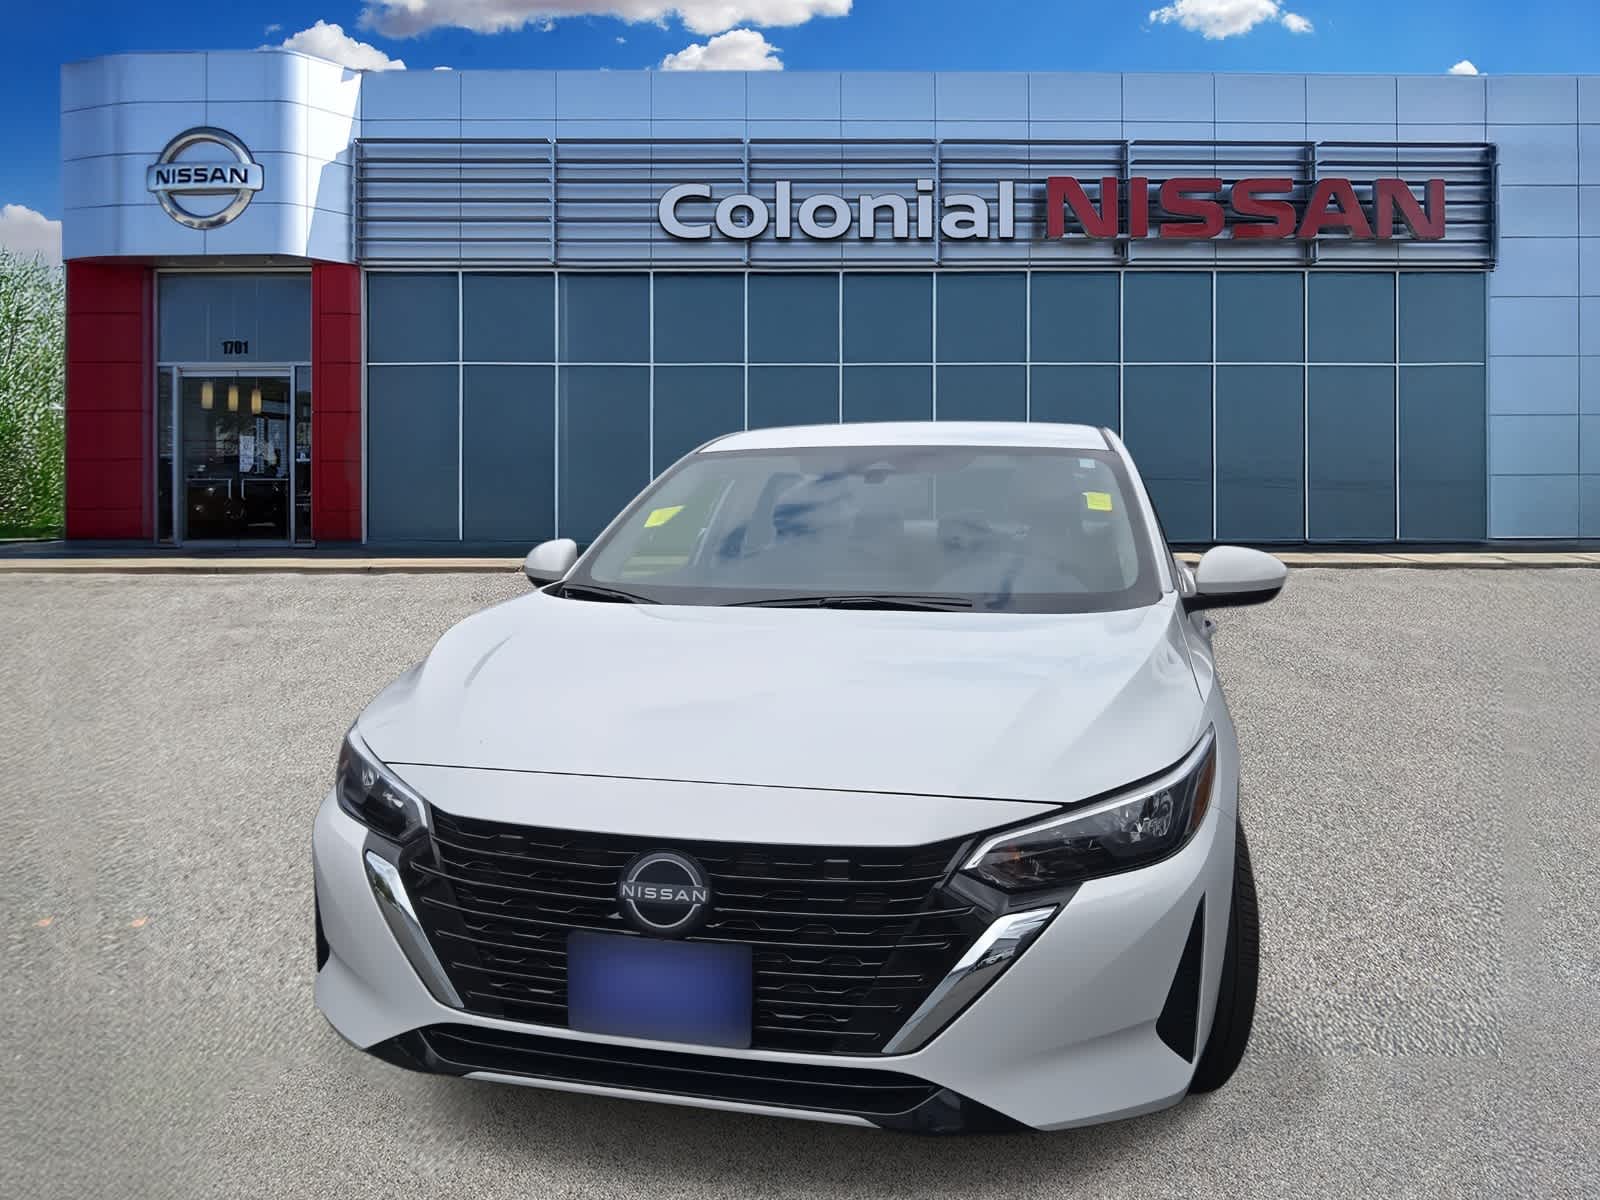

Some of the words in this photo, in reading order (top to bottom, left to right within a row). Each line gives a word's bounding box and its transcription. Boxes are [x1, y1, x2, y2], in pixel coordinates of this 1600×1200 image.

[155, 167, 248, 184] NISSAN
[658, 178, 1015, 240] Colonial
[1045, 176, 1446, 241] NISSAN
[222, 340, 249, 354] 1701
[622, 884, 706, 902] NISSAN
